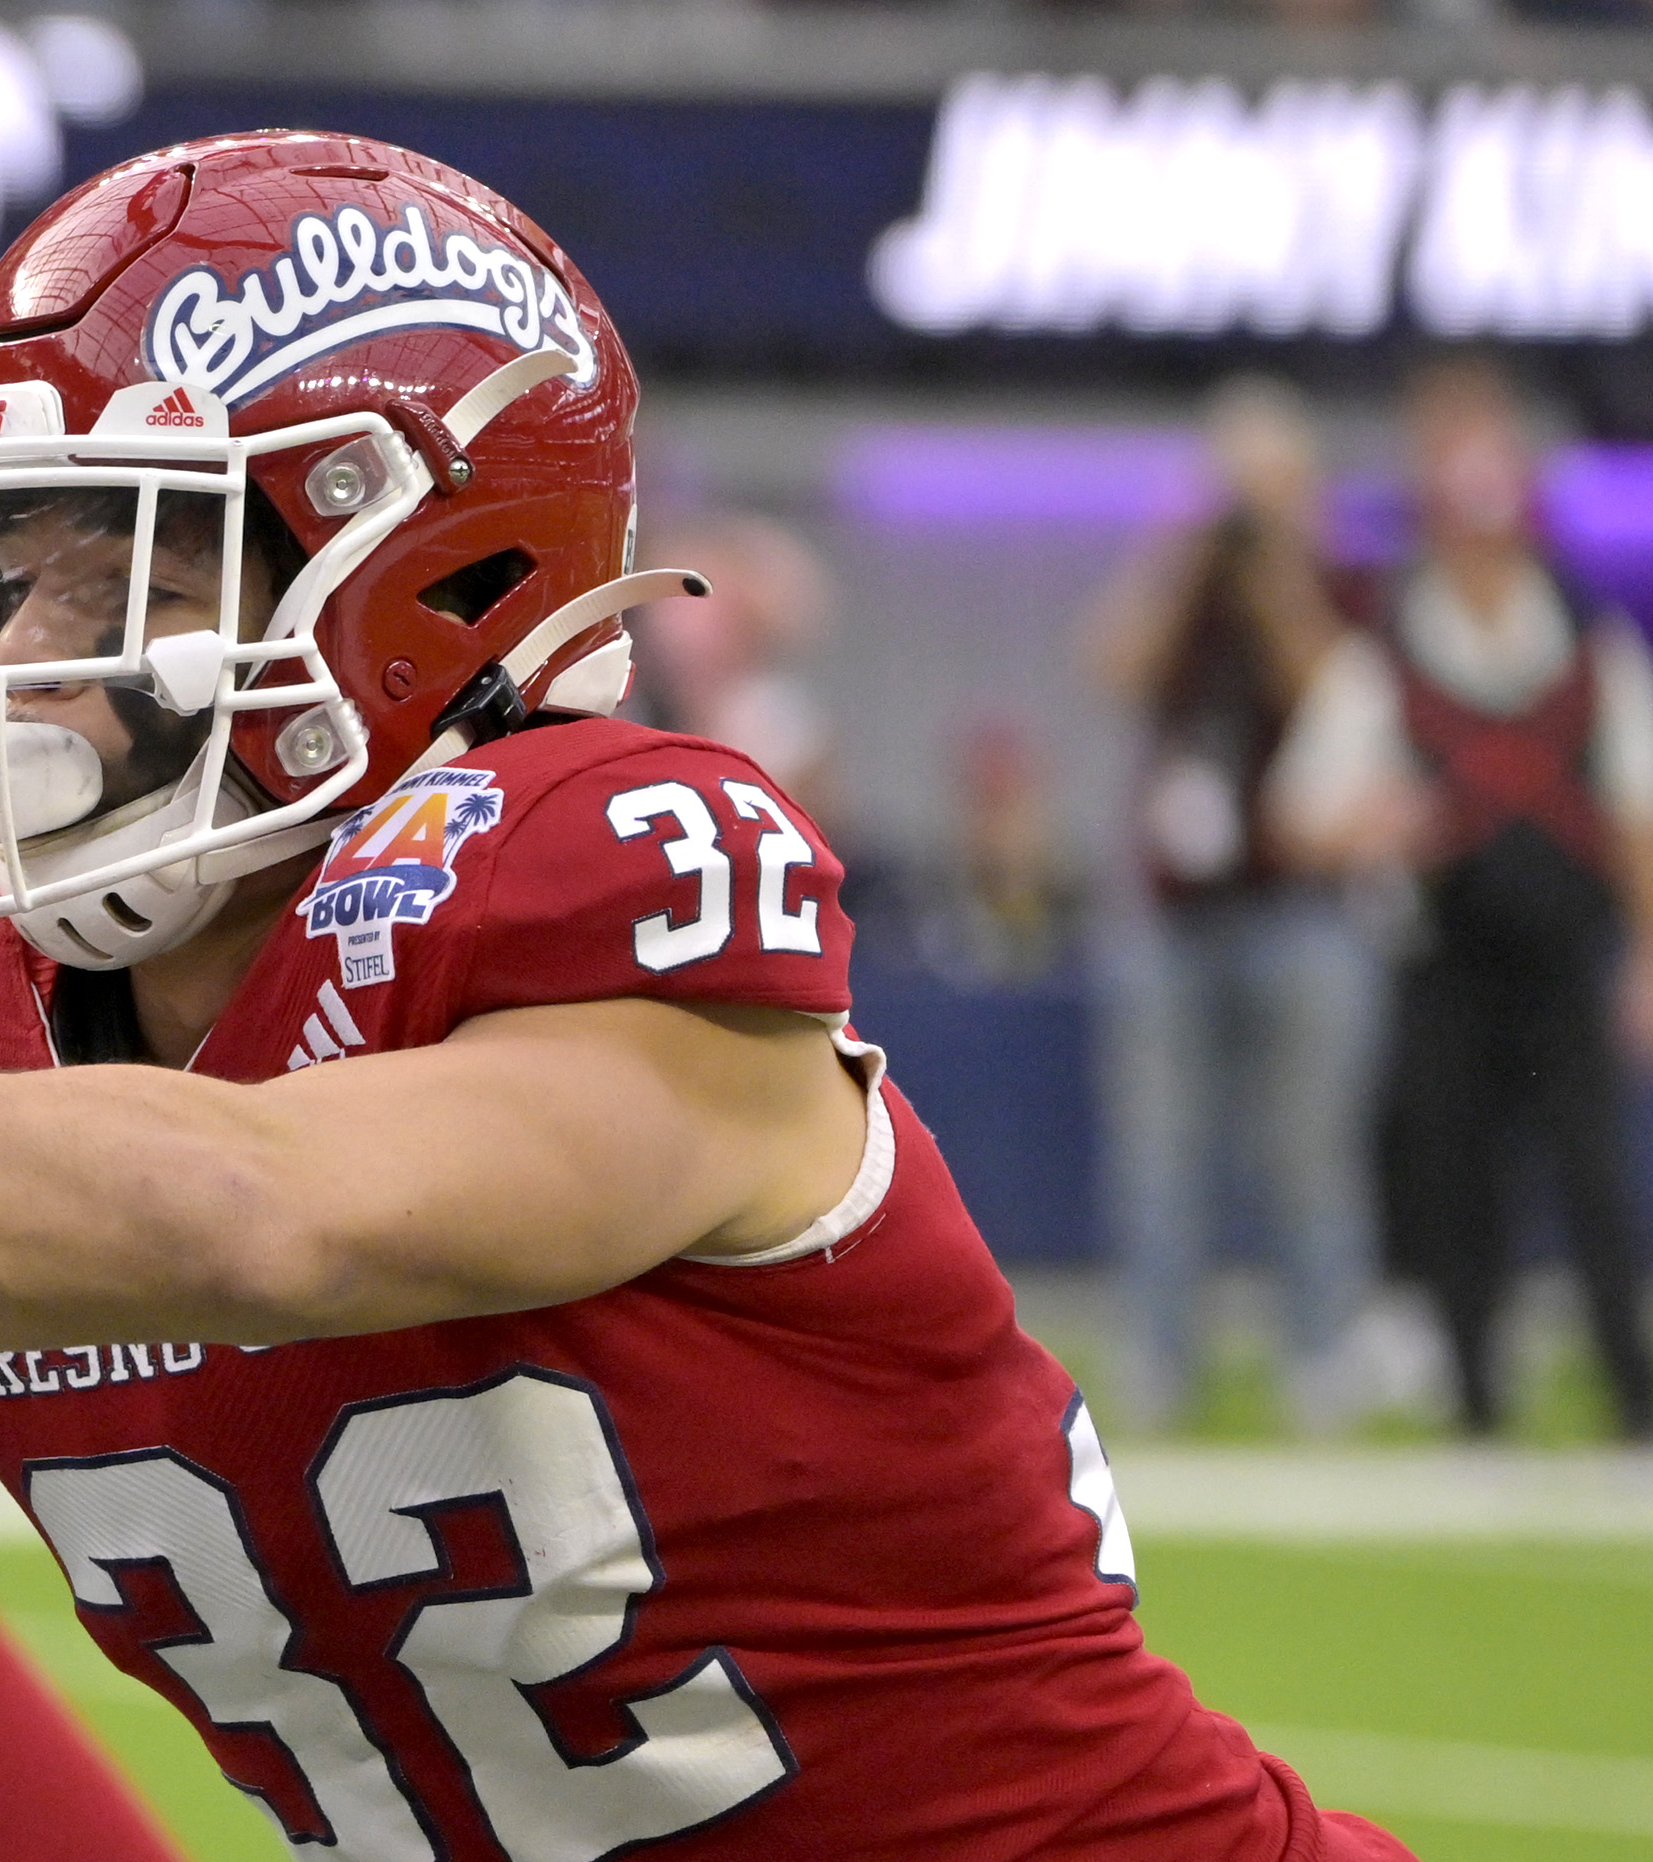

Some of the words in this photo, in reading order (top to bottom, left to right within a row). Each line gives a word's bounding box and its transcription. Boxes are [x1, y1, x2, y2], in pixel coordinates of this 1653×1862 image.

[149, 204, 599, 390] Bulldogs
[145, 411, 204, 428] adidas
[425, 771, 489, 787] KIMMEL
[320, 793, 449, 884] LA
[604, 777, 824, 976] 32
[310, 879, 429, 931] BOWL
[345, 954, 390, 983] STIFEL
